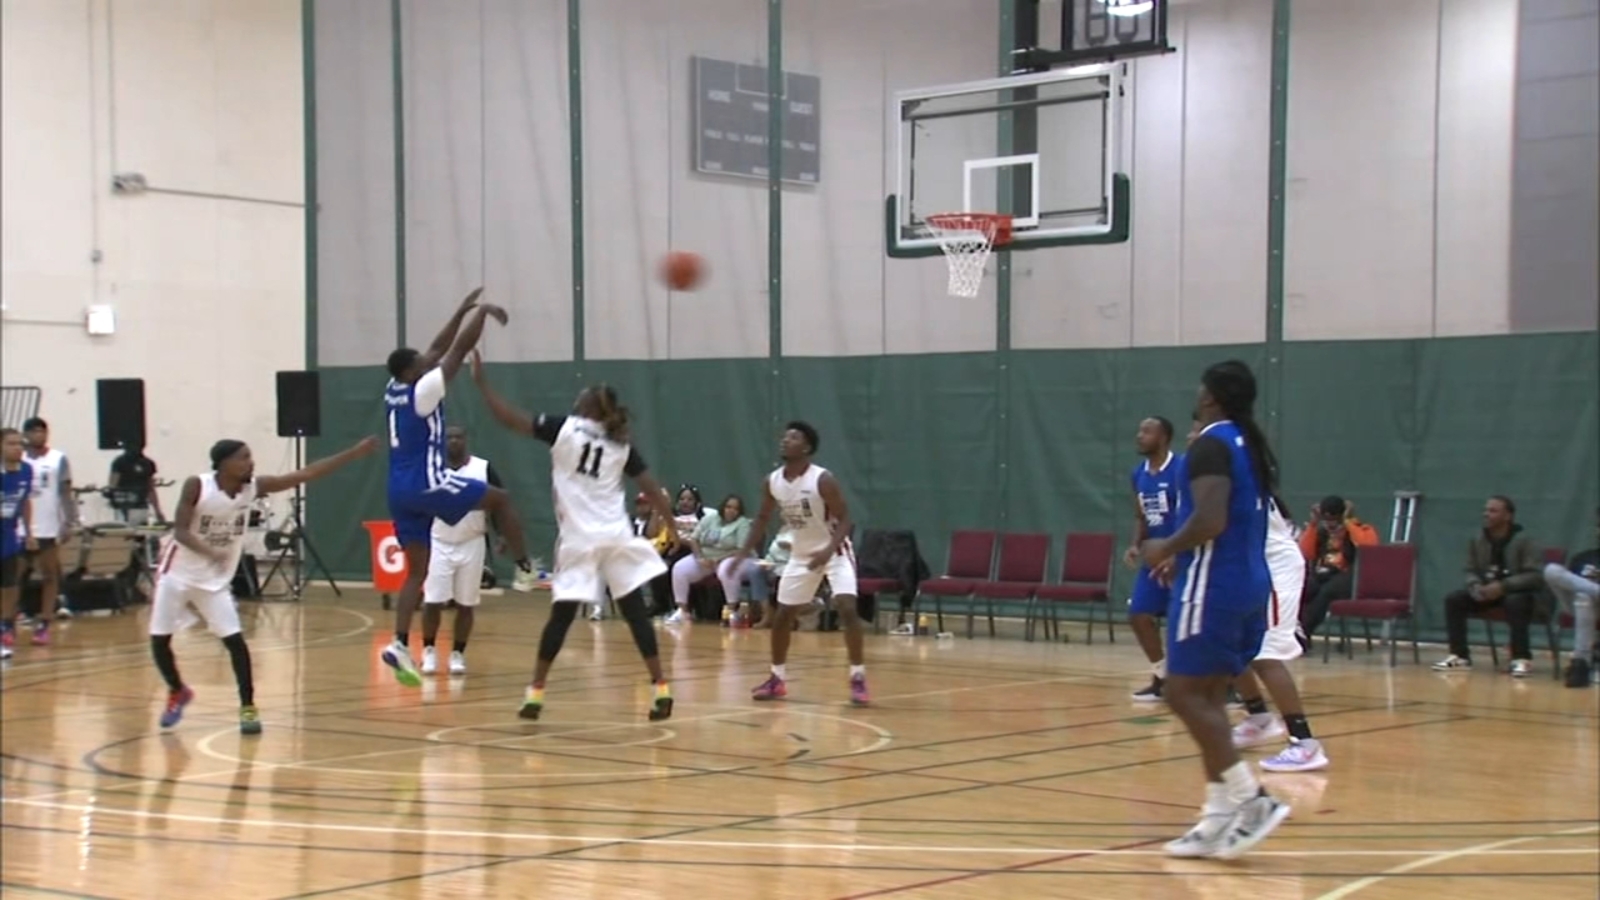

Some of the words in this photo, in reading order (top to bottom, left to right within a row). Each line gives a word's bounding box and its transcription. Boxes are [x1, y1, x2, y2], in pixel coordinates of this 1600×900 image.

[389, 409, 399, 447] 1
[576, 441, 604, 478] 11
[378, 535, 405, 573] G
